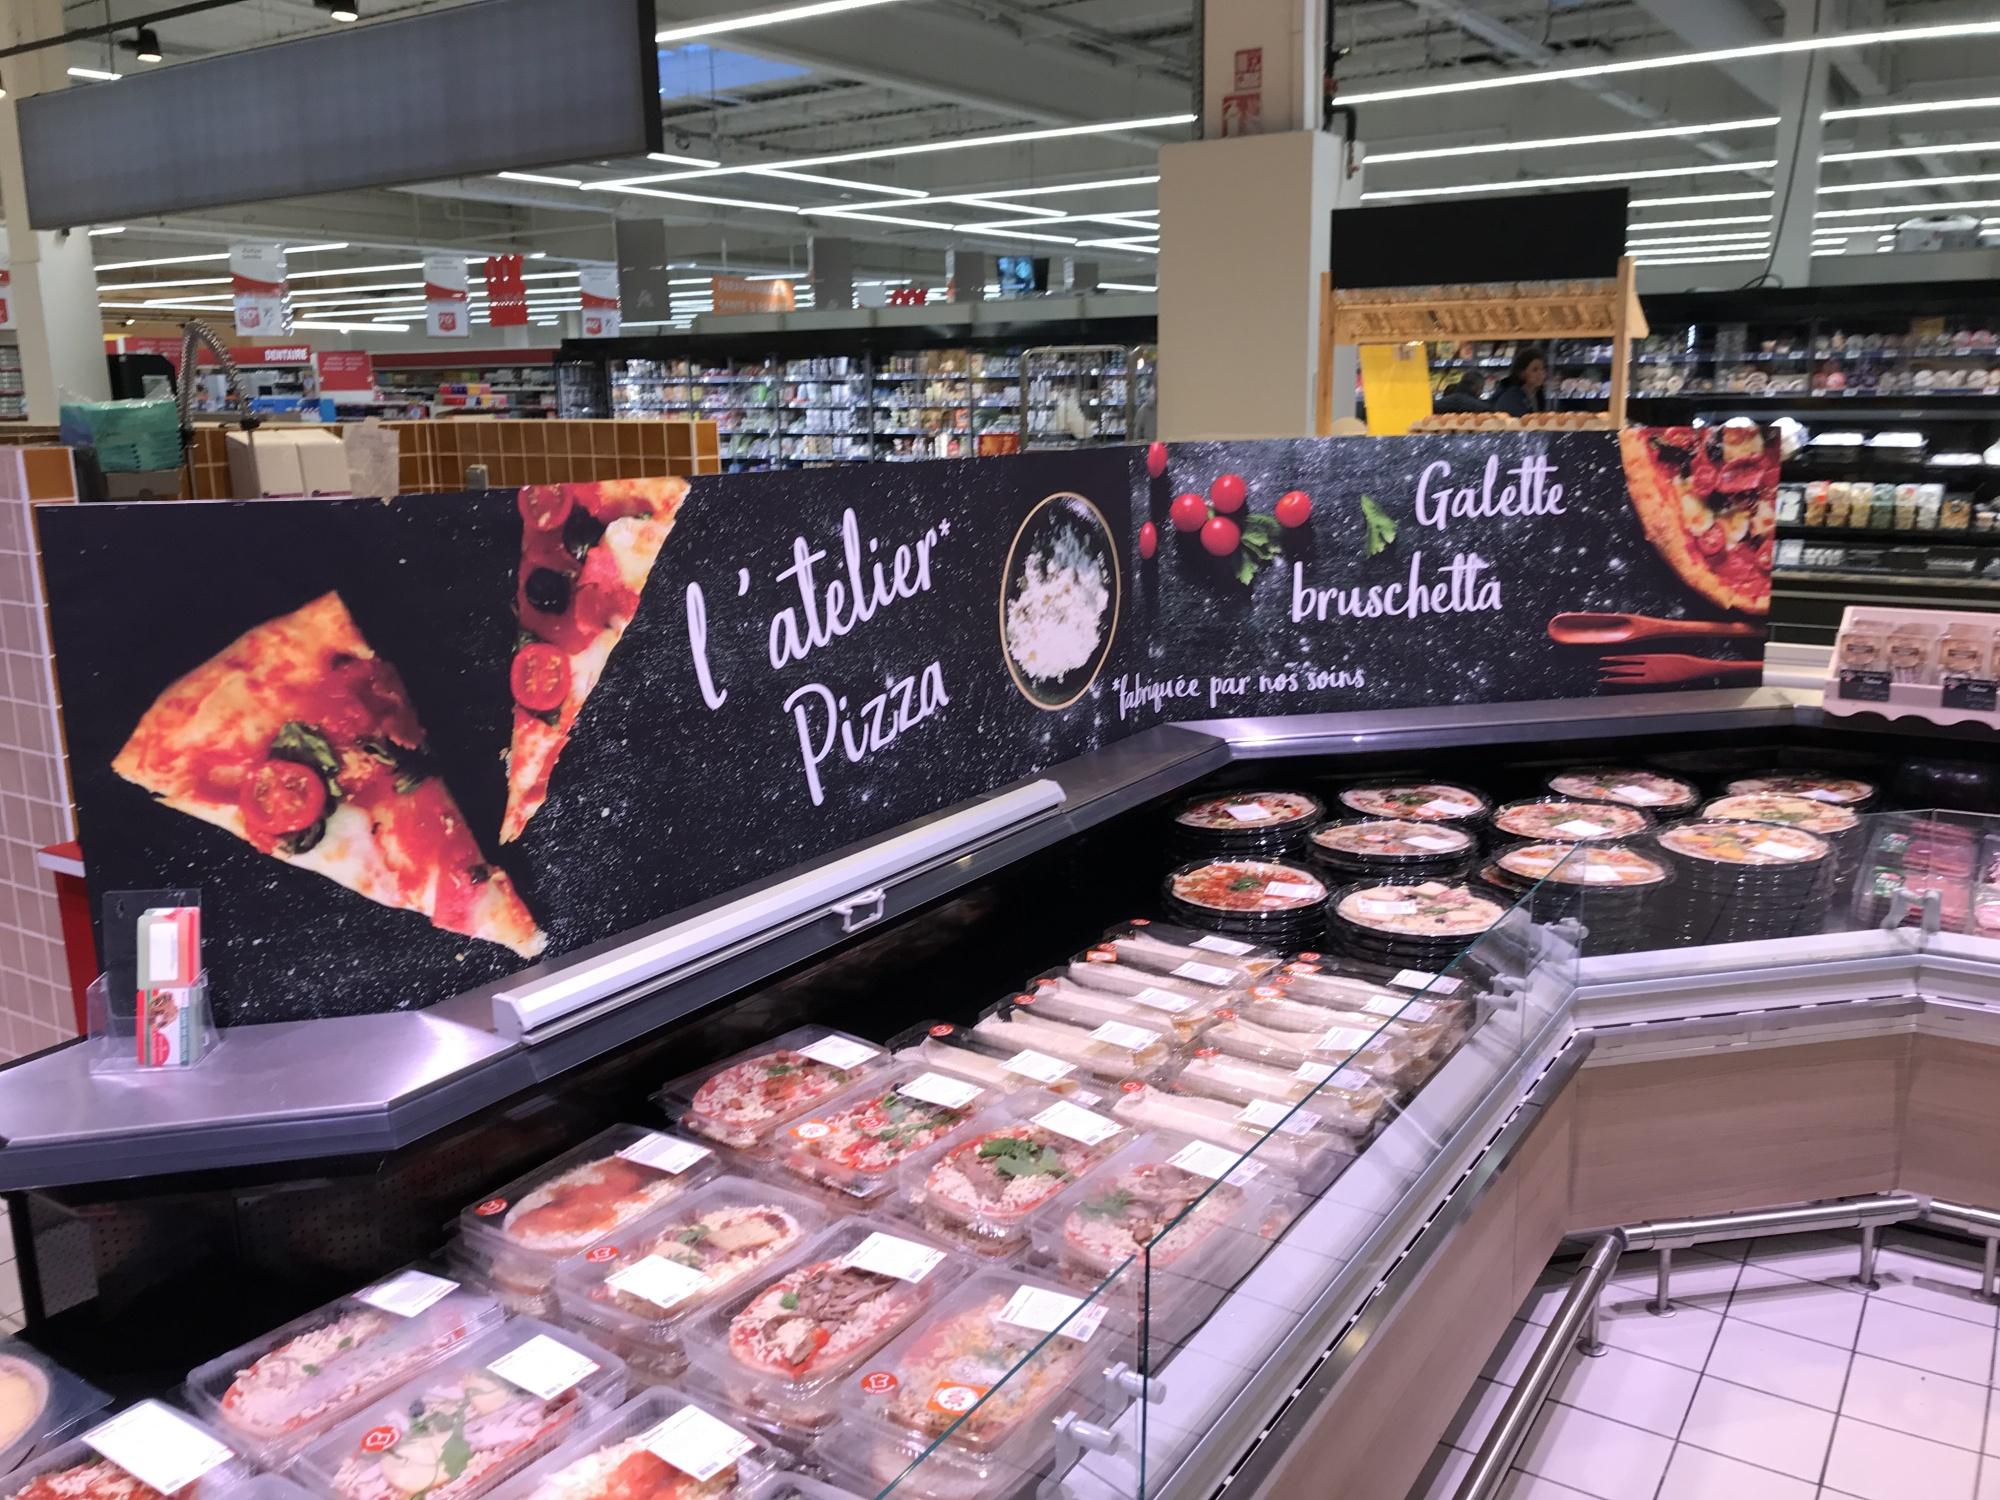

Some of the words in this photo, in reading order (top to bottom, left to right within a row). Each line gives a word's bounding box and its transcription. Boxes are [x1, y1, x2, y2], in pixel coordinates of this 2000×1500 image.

[1415, 454, 1567, 531] Galette
[1290, 551, 1503, 623] bruschetta
[1209, 675, 1251, 708] par
[1259, 671, 1299, 693] nos
[1306, 665, 1366, 691] soins
[783, 661, 950, 806] Pizza
